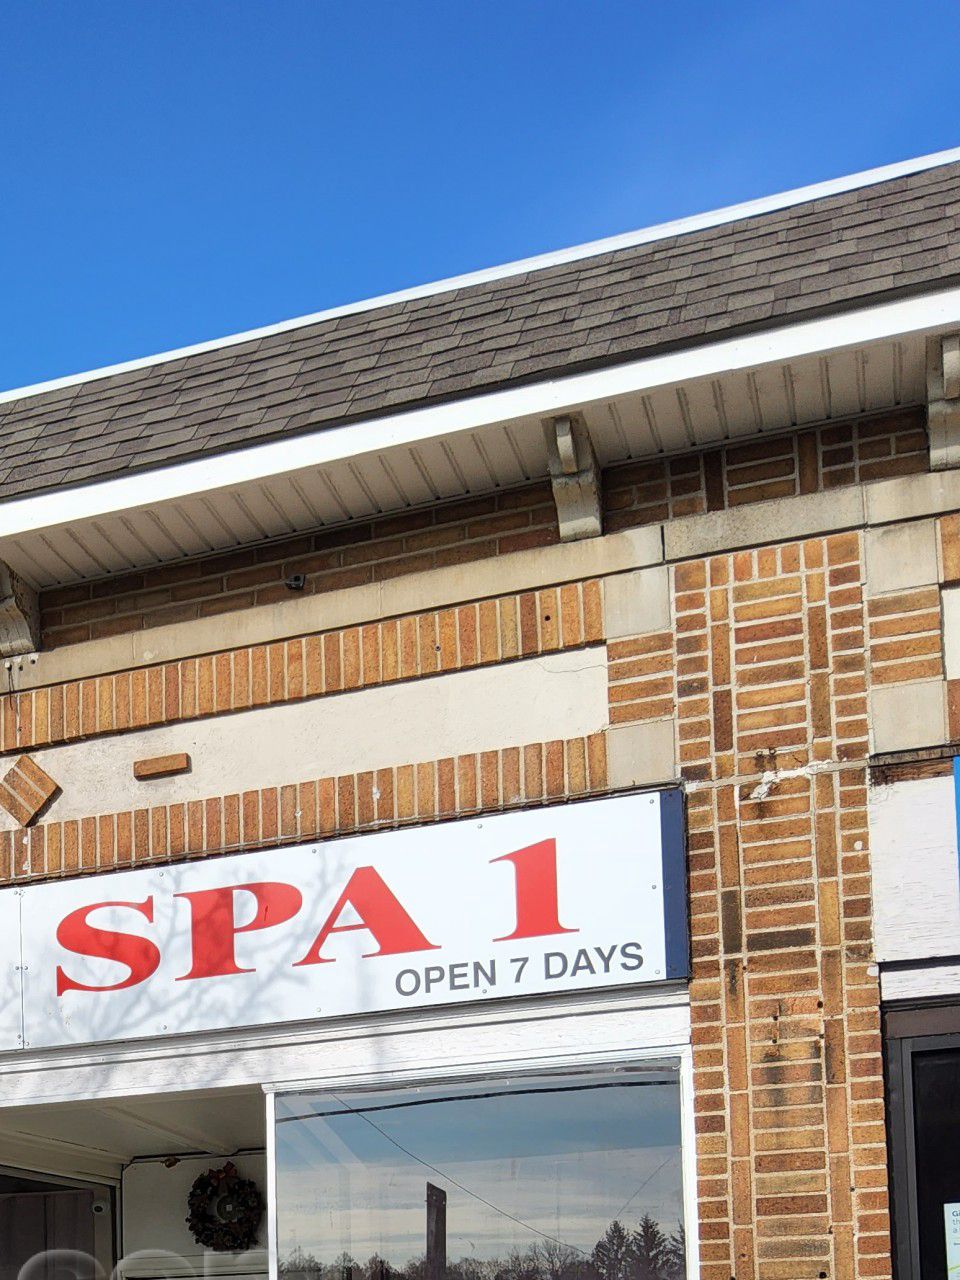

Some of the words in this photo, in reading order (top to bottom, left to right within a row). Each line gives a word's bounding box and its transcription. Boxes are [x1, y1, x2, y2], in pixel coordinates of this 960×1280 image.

[56, 866, 443, 997] SPA
[489, 838, 581, 942] 1
[395, 959, 497, 997] OPEN
[510, 956, 530, 984] 7
[544, 942, 645, 980] DAYS
